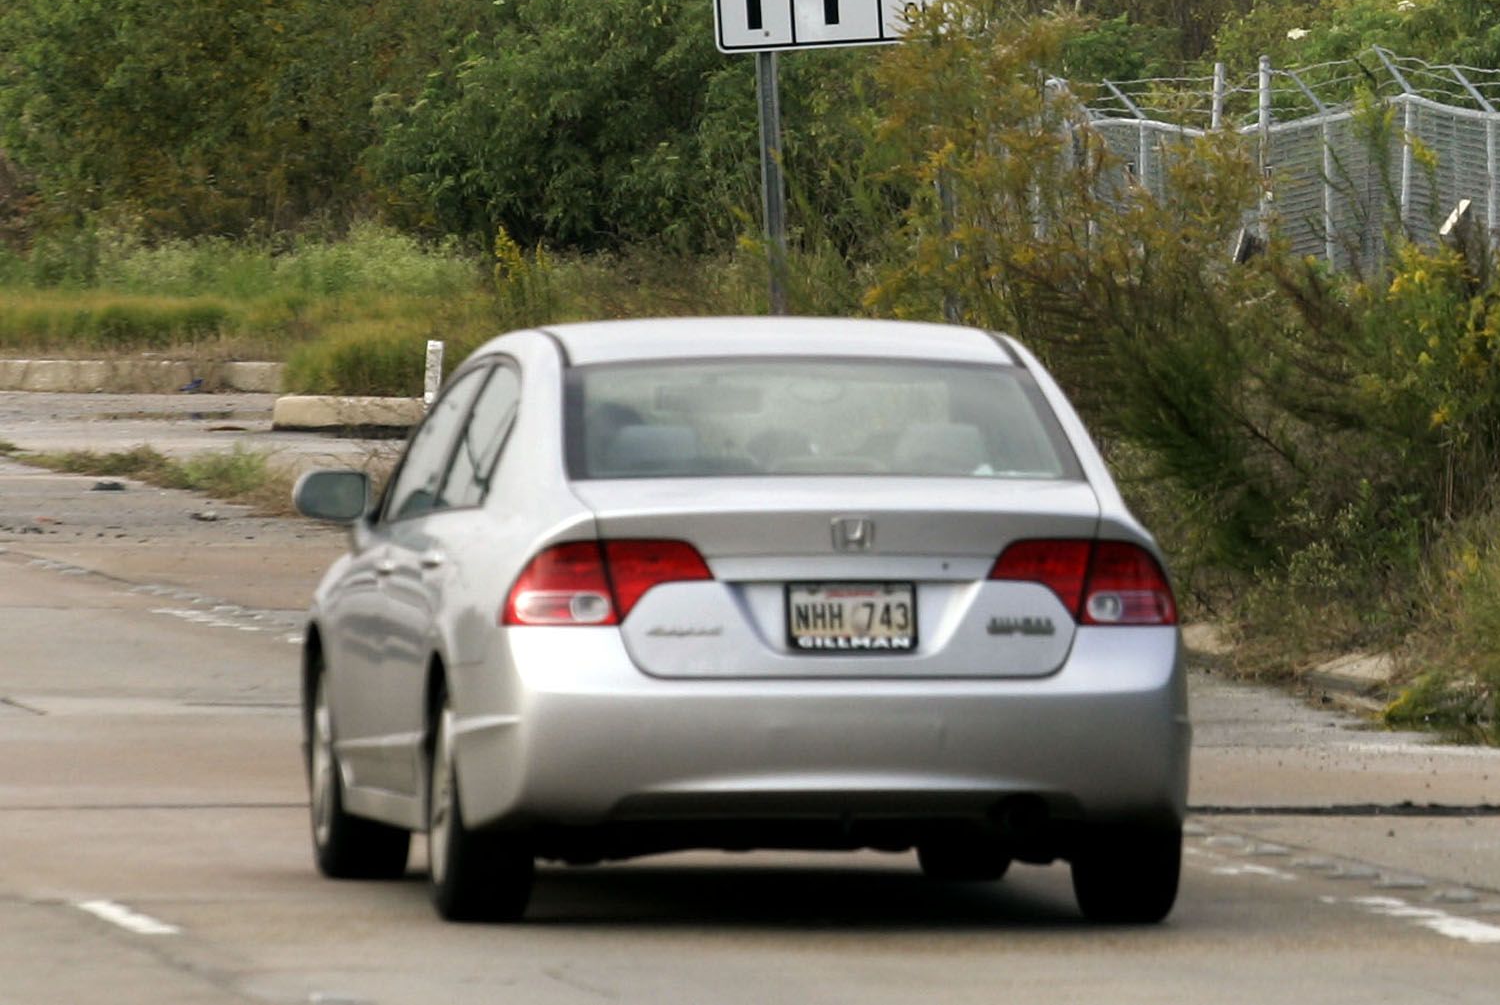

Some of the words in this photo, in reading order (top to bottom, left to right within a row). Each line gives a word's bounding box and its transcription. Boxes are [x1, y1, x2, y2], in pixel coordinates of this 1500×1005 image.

[796, 603, 843, 630] NHH
[862, 602, 909, 632] 743
[798, 636, 910, 648] GILLMAN
